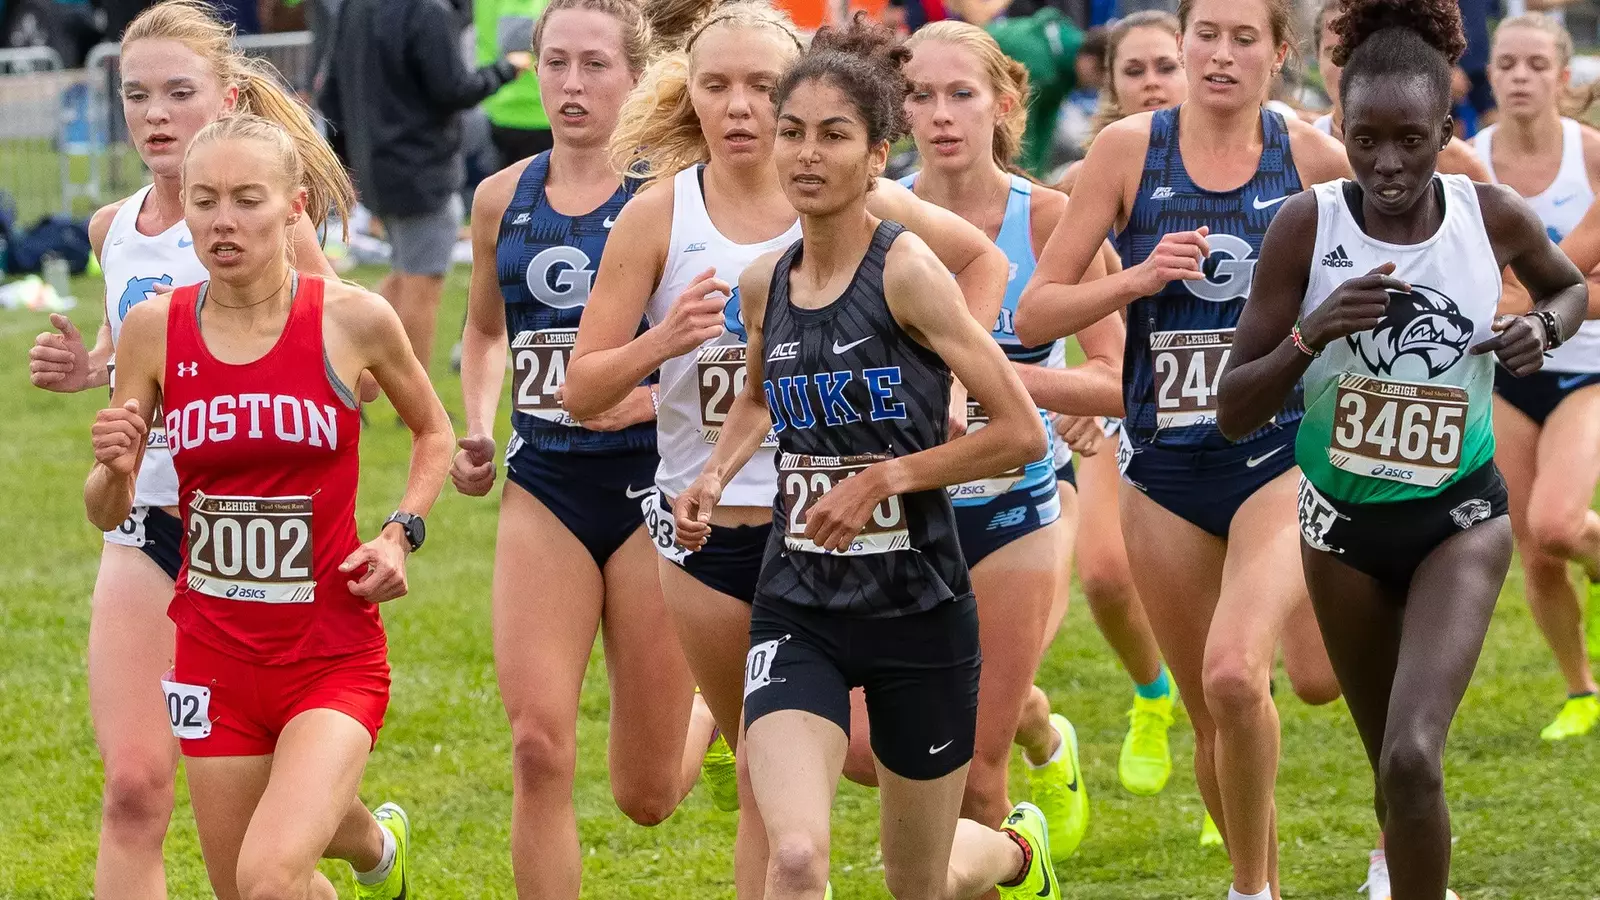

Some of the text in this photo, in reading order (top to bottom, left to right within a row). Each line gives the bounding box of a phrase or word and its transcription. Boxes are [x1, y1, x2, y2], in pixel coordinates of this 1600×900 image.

[684, 241, 708, 252] ACC
[1182, 233, 1258, 302] G
[1321, 256, 1353, 268] adidas
[526, 246, 596, 310] G
[545, 333, 576, 344] LEHIGH
[1186, 333, 1221, 345] LEHIGH
[767, 341, 801, 362] ACC
[1380, 383, 1419, 397] LEHIGH
[166, 393, 338, 457] BOSTON
[1335, 392, 1463, 465] 3465
[809, 455, 841, 467] LEHIGH
[1384, 466, 1414, 480] asics
[961, 484, 985, 495] asics
[218, 501, 257, 512] LEHIGH
[189, 512, 309, 579] 2002
[238, 587, 266, 599] asics
[167, 692, 202, 727] 02
